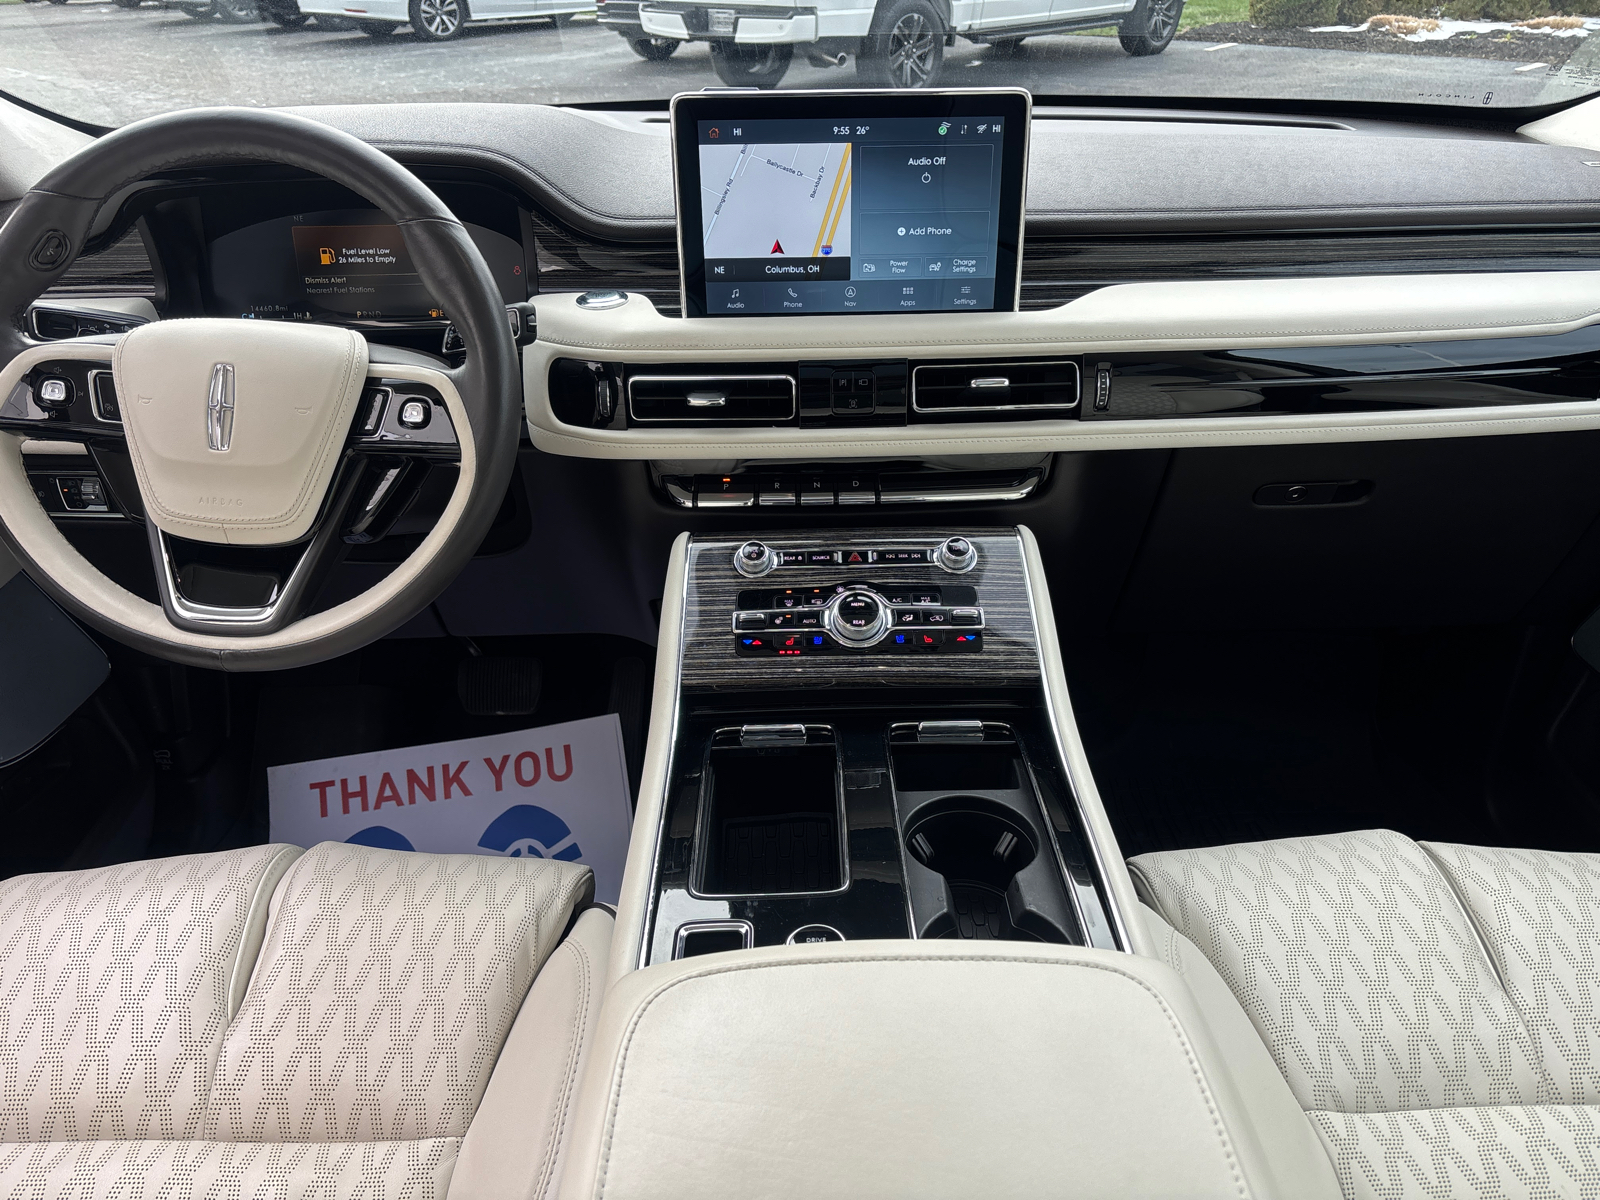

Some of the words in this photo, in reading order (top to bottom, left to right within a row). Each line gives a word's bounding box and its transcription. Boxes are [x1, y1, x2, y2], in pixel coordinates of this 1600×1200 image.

[733, 127, 742, 136] HI
[833, 126, 850, 136] 9:55
[856, 126, 870, 135] 26°
[992, 124, 1001, 134] HI
[908, 156, 932, 166] Audio
[933, 156, 946, 166] Off
[766, 158, 796, 176] Ballycastle
[810, 173, 824, 198] Backbay
[714, 188, 730, 216] Billingsley
[726, 178, 734, 188] Rd
[908, 226, 924, 236] Add
[926, 226, 952, 236] Phone
[357, 247, 375, 255] Level
[376, 247, 390, 255] Low
[375, 256, 396, 264] Empty
[953, 258, 976, 268] Charge
[714, 266, 725, 274] NE
[765, 264, 806, 275] Columbus,
[808, 264, 820, 274] OH
[892, 266, 906, 274] Flow
[952, 266, 976, 274] Settings
[783, 300, 803, 308] Phone
[900, 300, 916, 308] Apps
[954, 298, 976, 306] Settings
[199, 497, 244, 506] AIRBAG
[309, 760, 473, 818] THANK
[483, 744, 574, 792] YOU
